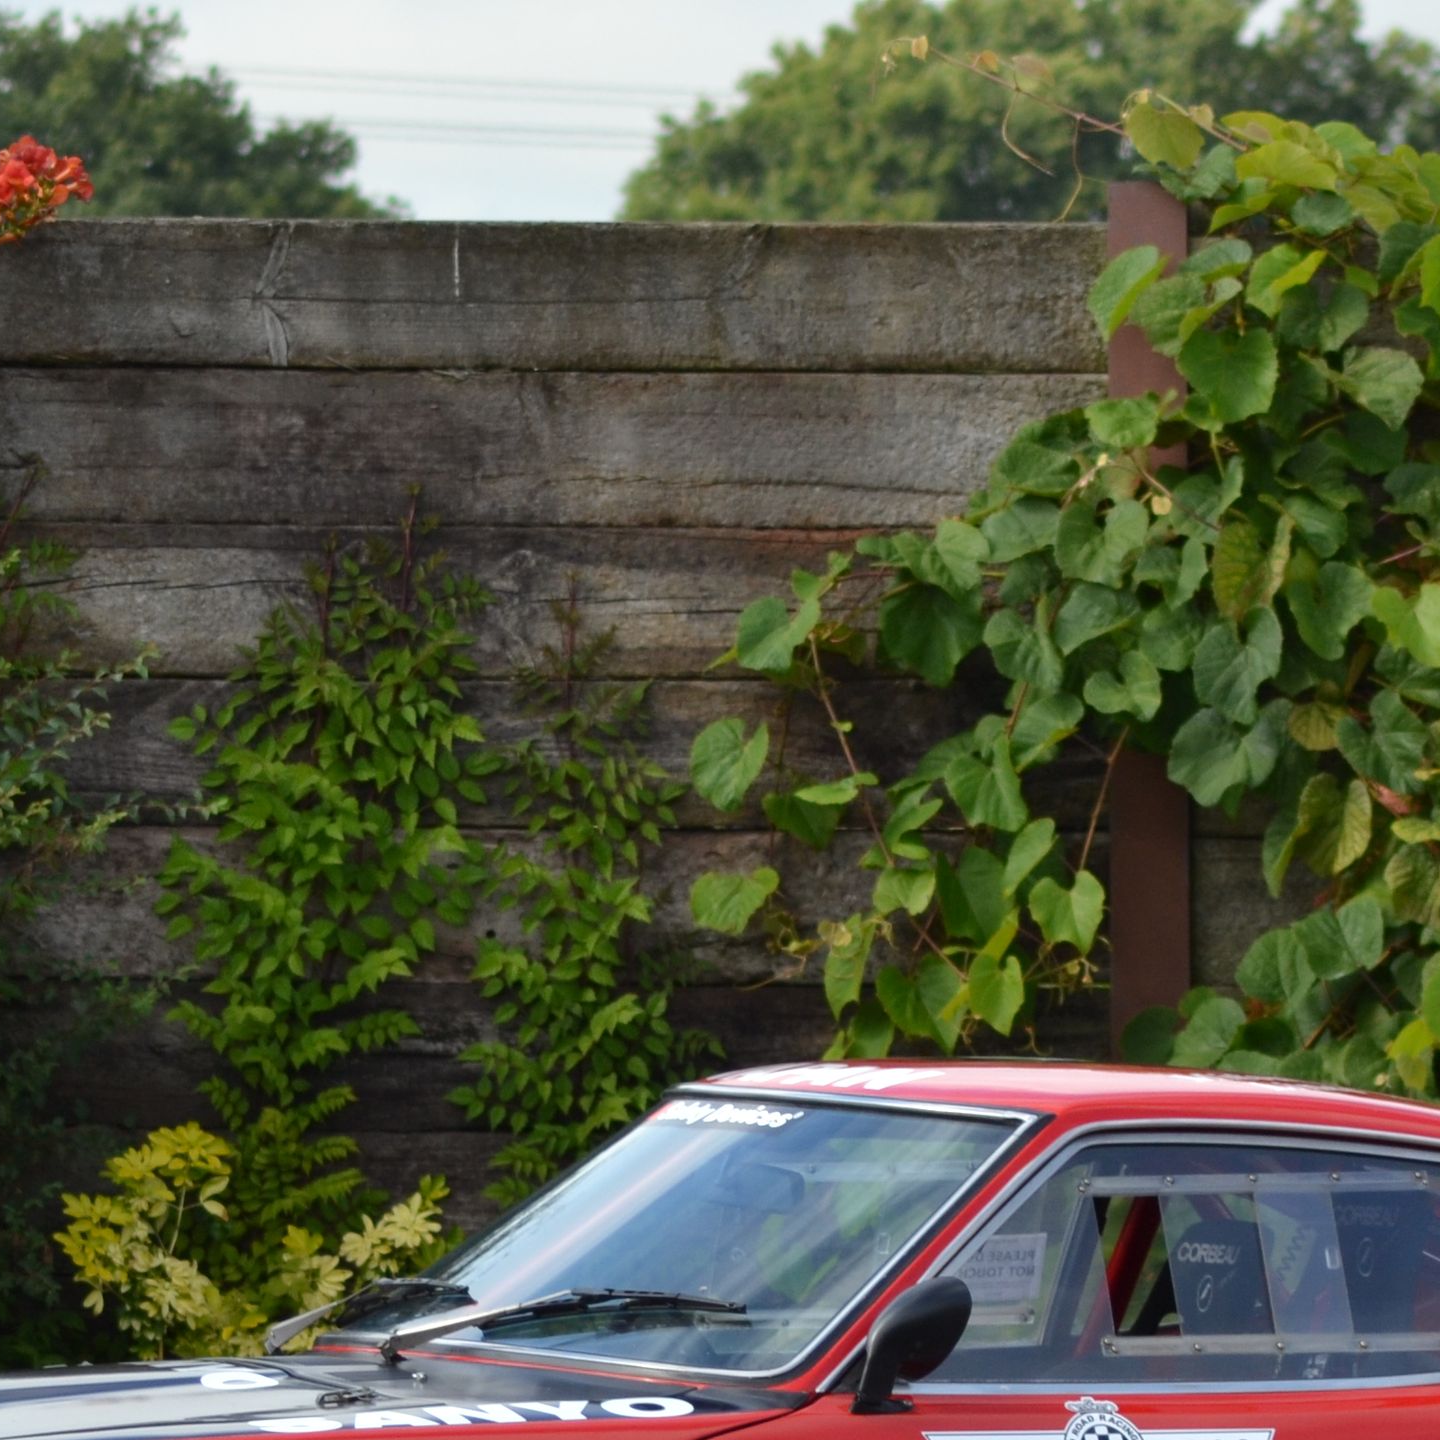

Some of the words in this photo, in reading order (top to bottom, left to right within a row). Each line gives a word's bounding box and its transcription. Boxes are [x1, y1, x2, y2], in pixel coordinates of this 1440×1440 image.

[1176, 1241, 1241, 1265] CORBEAU
[248, 1396, 695, 1434] SANYO
[1071, 1414, 1096, 1437] ROAD
